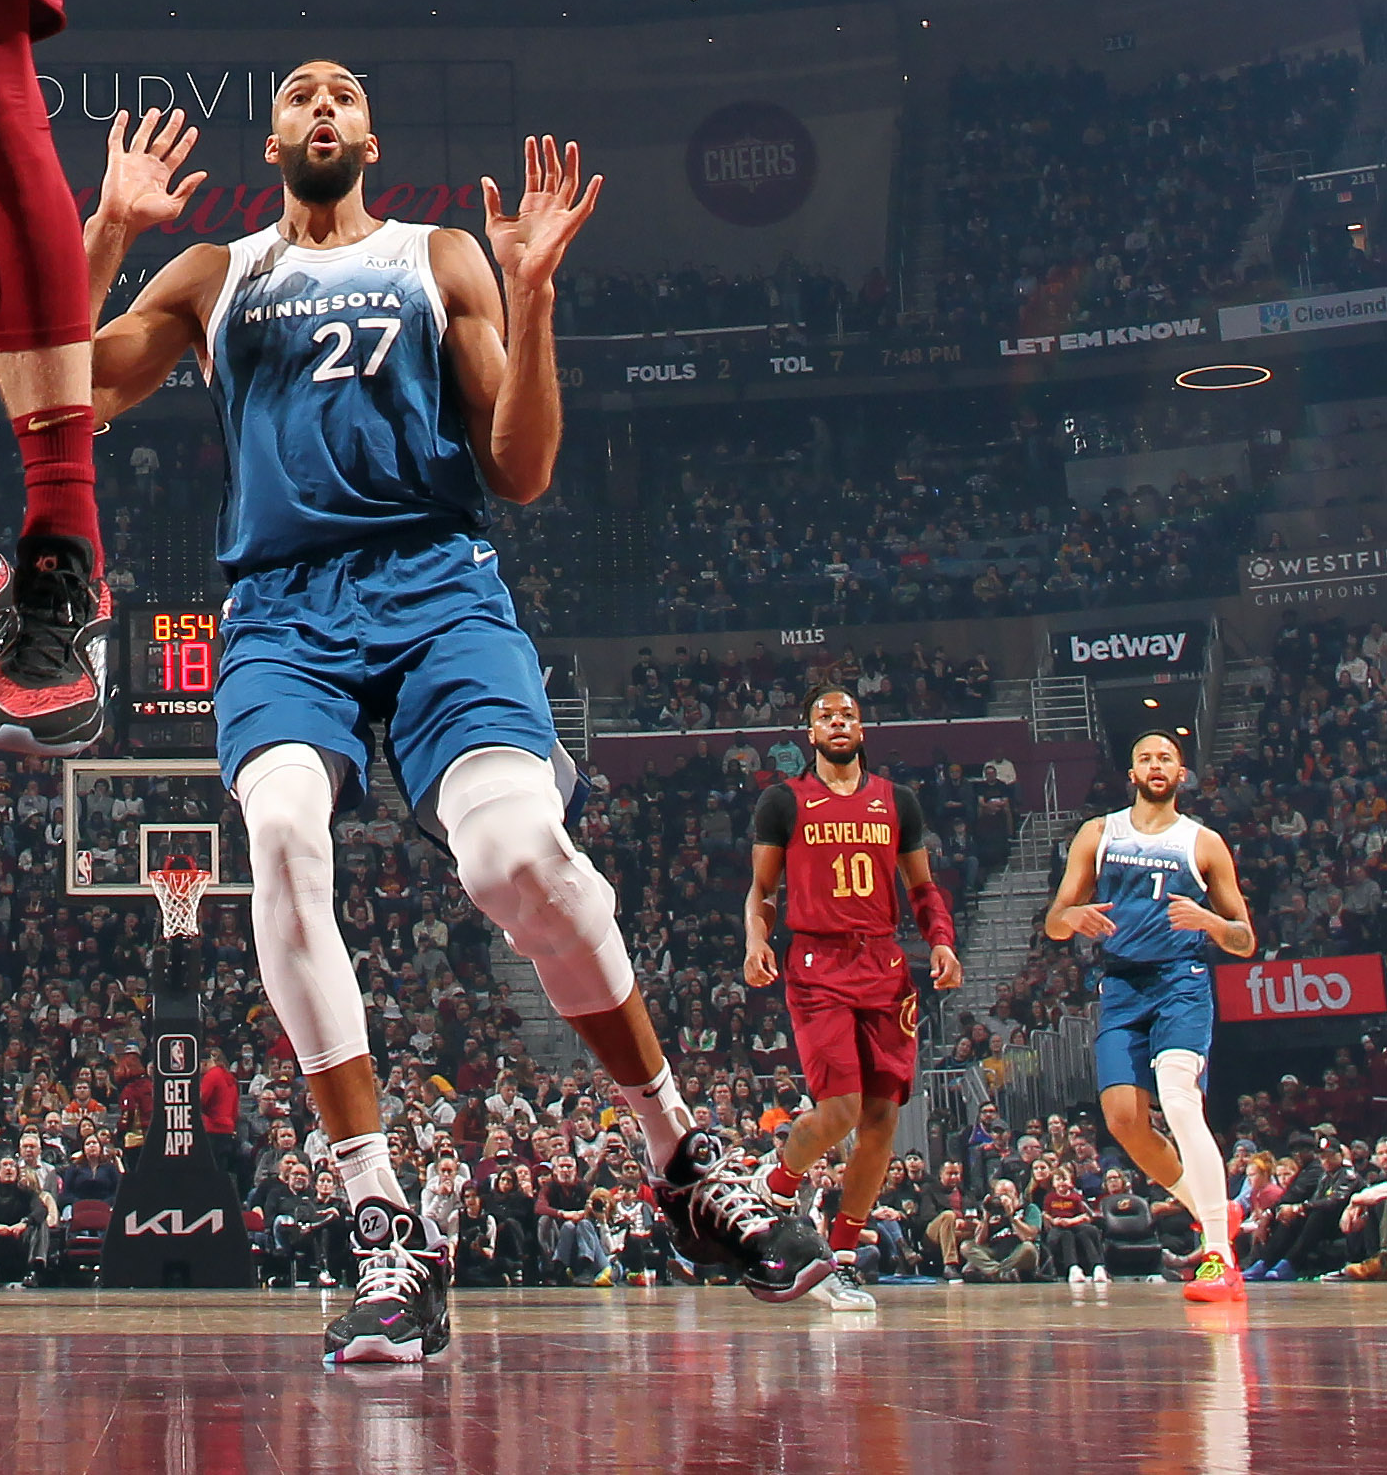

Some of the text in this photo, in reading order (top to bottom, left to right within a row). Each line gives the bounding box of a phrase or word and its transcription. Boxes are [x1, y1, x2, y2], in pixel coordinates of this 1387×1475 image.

[703, 143, 797, 182] CHEERS
[244, 292, 402, 324] MINNESOTA
[1295, 299, 1387, 324] Cleveland
[312, 317, 402, 382] 27
[999, 317, 1207, 356] LET EM KNOW.
[626, 362, 696, 383] FOULS
[718, 359, 731, 379] 2
[770, 356, 812, 373] TOL
[829, 351, 844, 371] 7
[930, 345, 961, 363] PM
[1278, 550, 1387, 577] WESTFI
[1255, 583, 1378, 606] CHAMPIONS
[154, 614, 215, 640] 8:54
[781, 628, 825, 645] M115
[1070, 631, 1186, 663] betway
[163, 641, 212, 692] 18
[157, 700, 215, 714] TISSO
[803, 821, 891, 845] CLEVELAND
[832, 852, 874, 898] 10
[1106, 853, 1180, 871] MINNESOTA
[1150, 872, 1165, 900] 1
[1245, 962, 1352, 1015] fubo
[164, 1079, 192, 1104] GET
[164, 1105, 193, 1130] THE
[164, 1131, 194, 1156] APP
